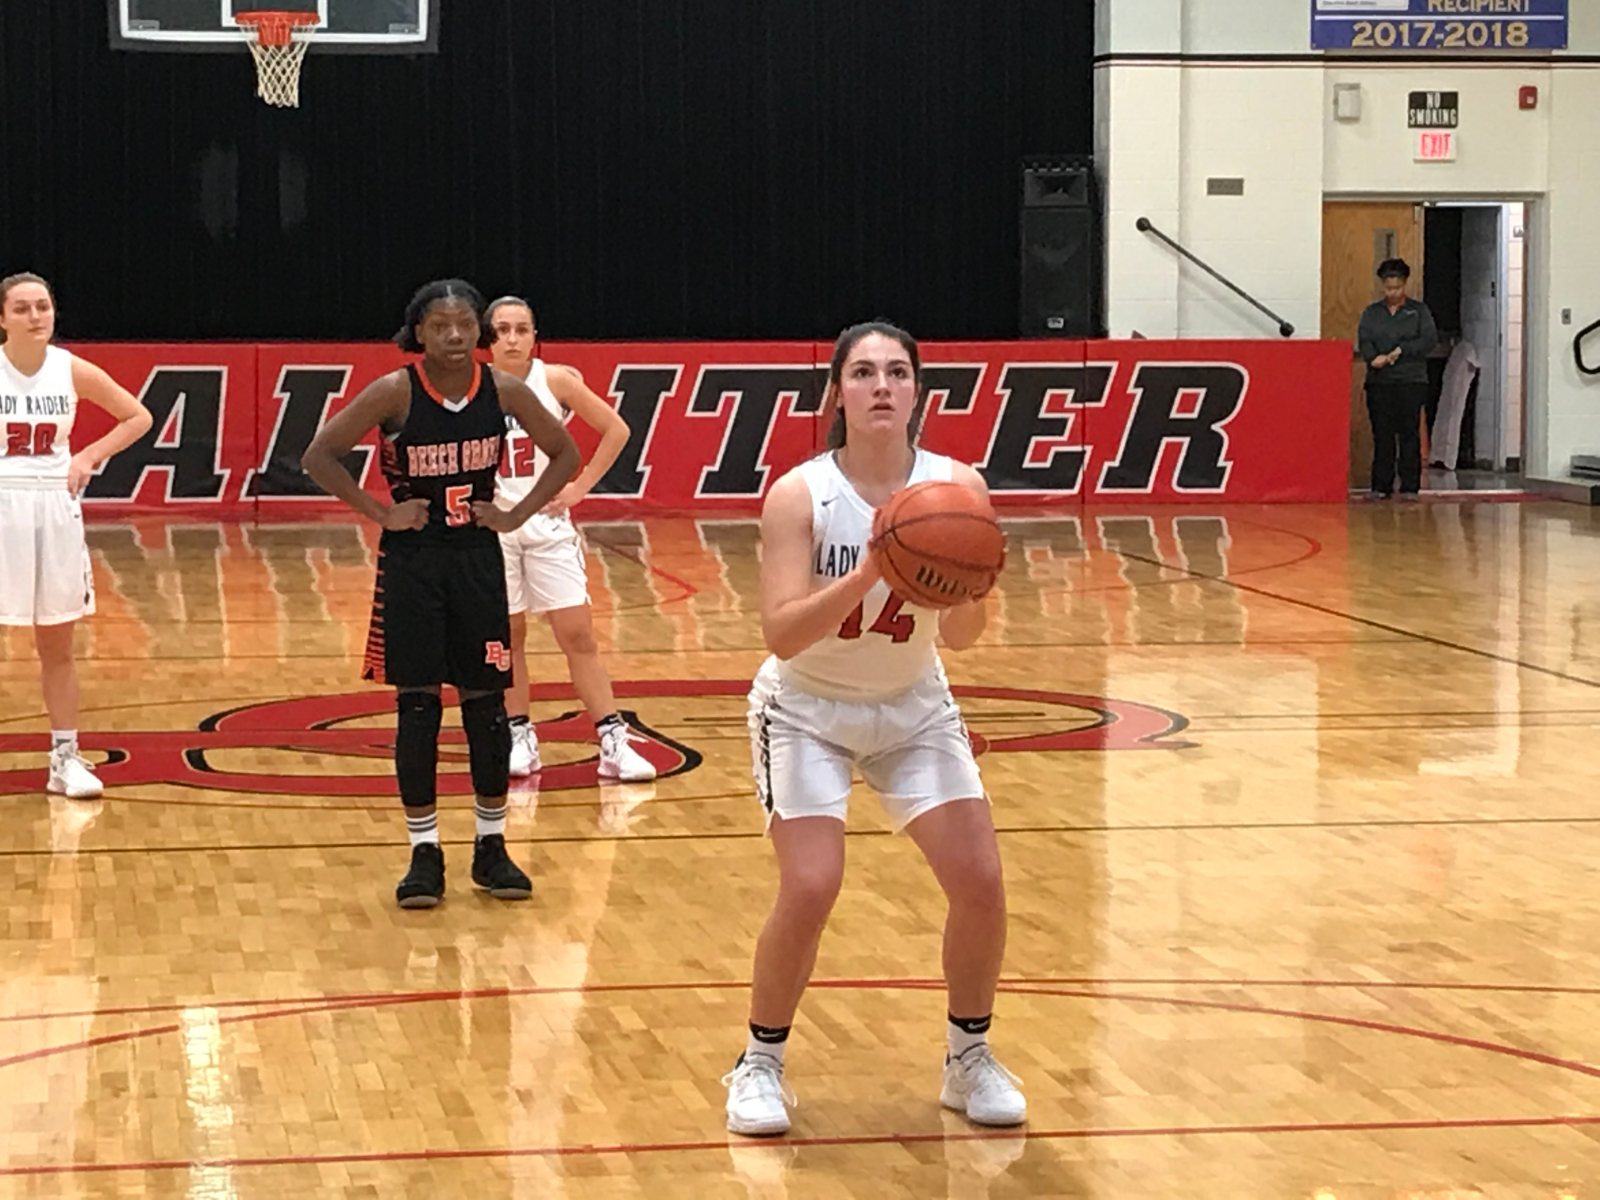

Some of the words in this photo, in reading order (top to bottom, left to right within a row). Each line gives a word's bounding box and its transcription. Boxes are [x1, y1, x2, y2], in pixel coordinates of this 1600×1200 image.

[1352, 21, 1529, 47] 2017-2018
[1426, 92, 1441, 109] NO
[1409, 108, 1457, 126] SMOKING
[1420, 132, 1451, 158] EXIT
[25, 395, 70, 416] RAIDERS
[5, 422, 58, 457] 20
[445, 483, 473, 527] 5
[815, 541, 860, 579] LADY
